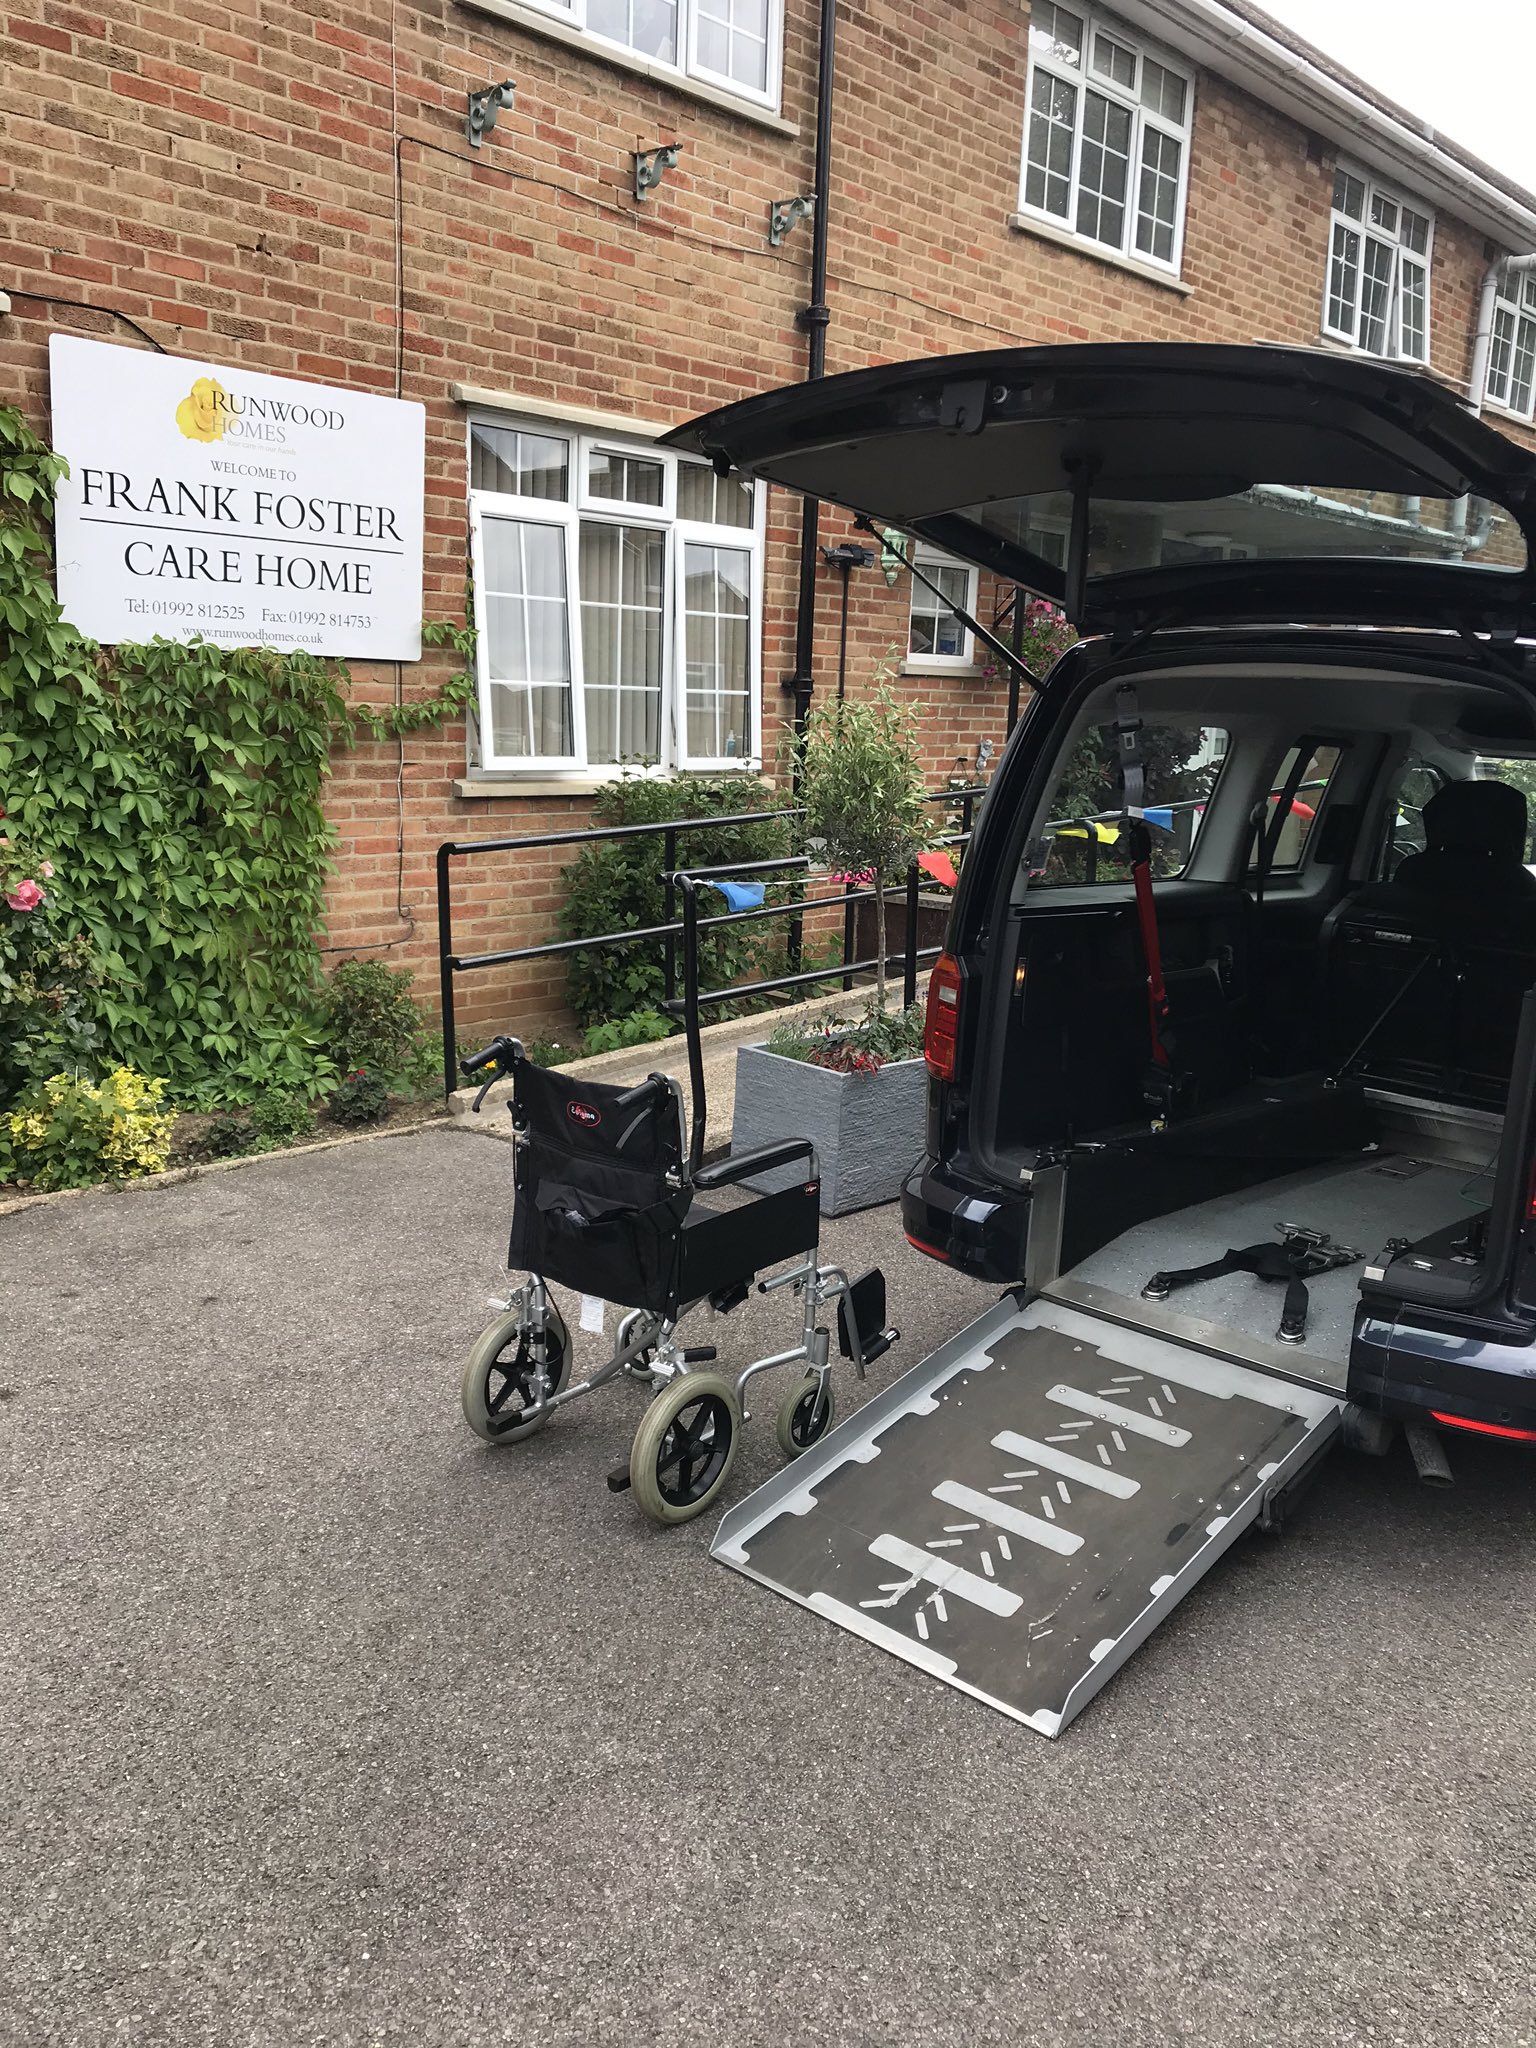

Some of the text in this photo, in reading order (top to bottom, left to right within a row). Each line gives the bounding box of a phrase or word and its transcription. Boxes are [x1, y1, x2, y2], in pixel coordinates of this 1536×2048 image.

[212, 390, 345, 431] RUNWOOD
[212, 415, 286, 443] HOMES
[210, 460, 297, 482] WELCOME TO
[80, 468, 404, 542] FRANK FOSTER
[124, 541, 373, 595] CARE HOME
[125, 598, 372, 629] Tel: 01992 812525 Fax: 01992 814753
[182, 626, 324, 644] www.runwoodhomes.co.uk
